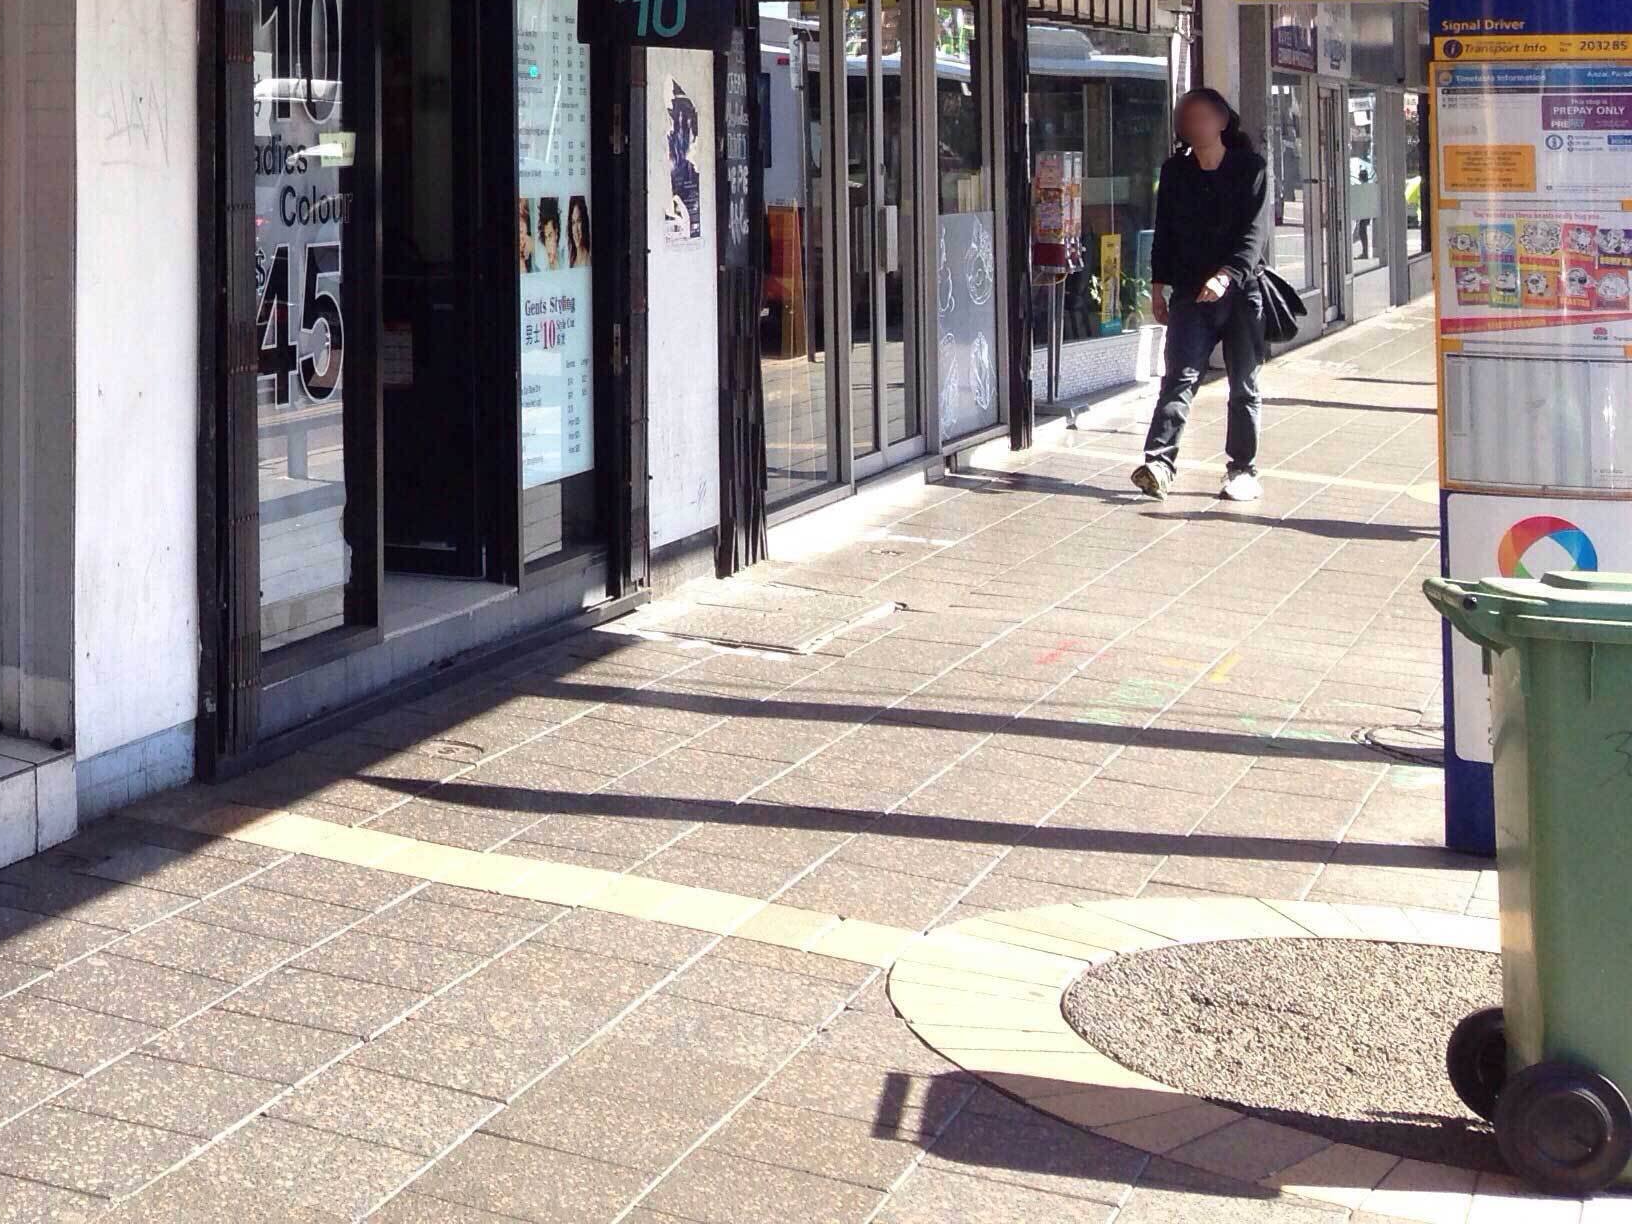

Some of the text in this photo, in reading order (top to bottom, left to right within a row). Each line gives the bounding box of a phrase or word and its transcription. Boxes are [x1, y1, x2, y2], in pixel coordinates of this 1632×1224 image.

[1441, 19, 1525, 33] Signal Driver
[1465, 42, 1548, 55] Transport Info
[1553, 106, 1625, 116] PREPAY ONLY
[253, 135, 307, 175] adies
